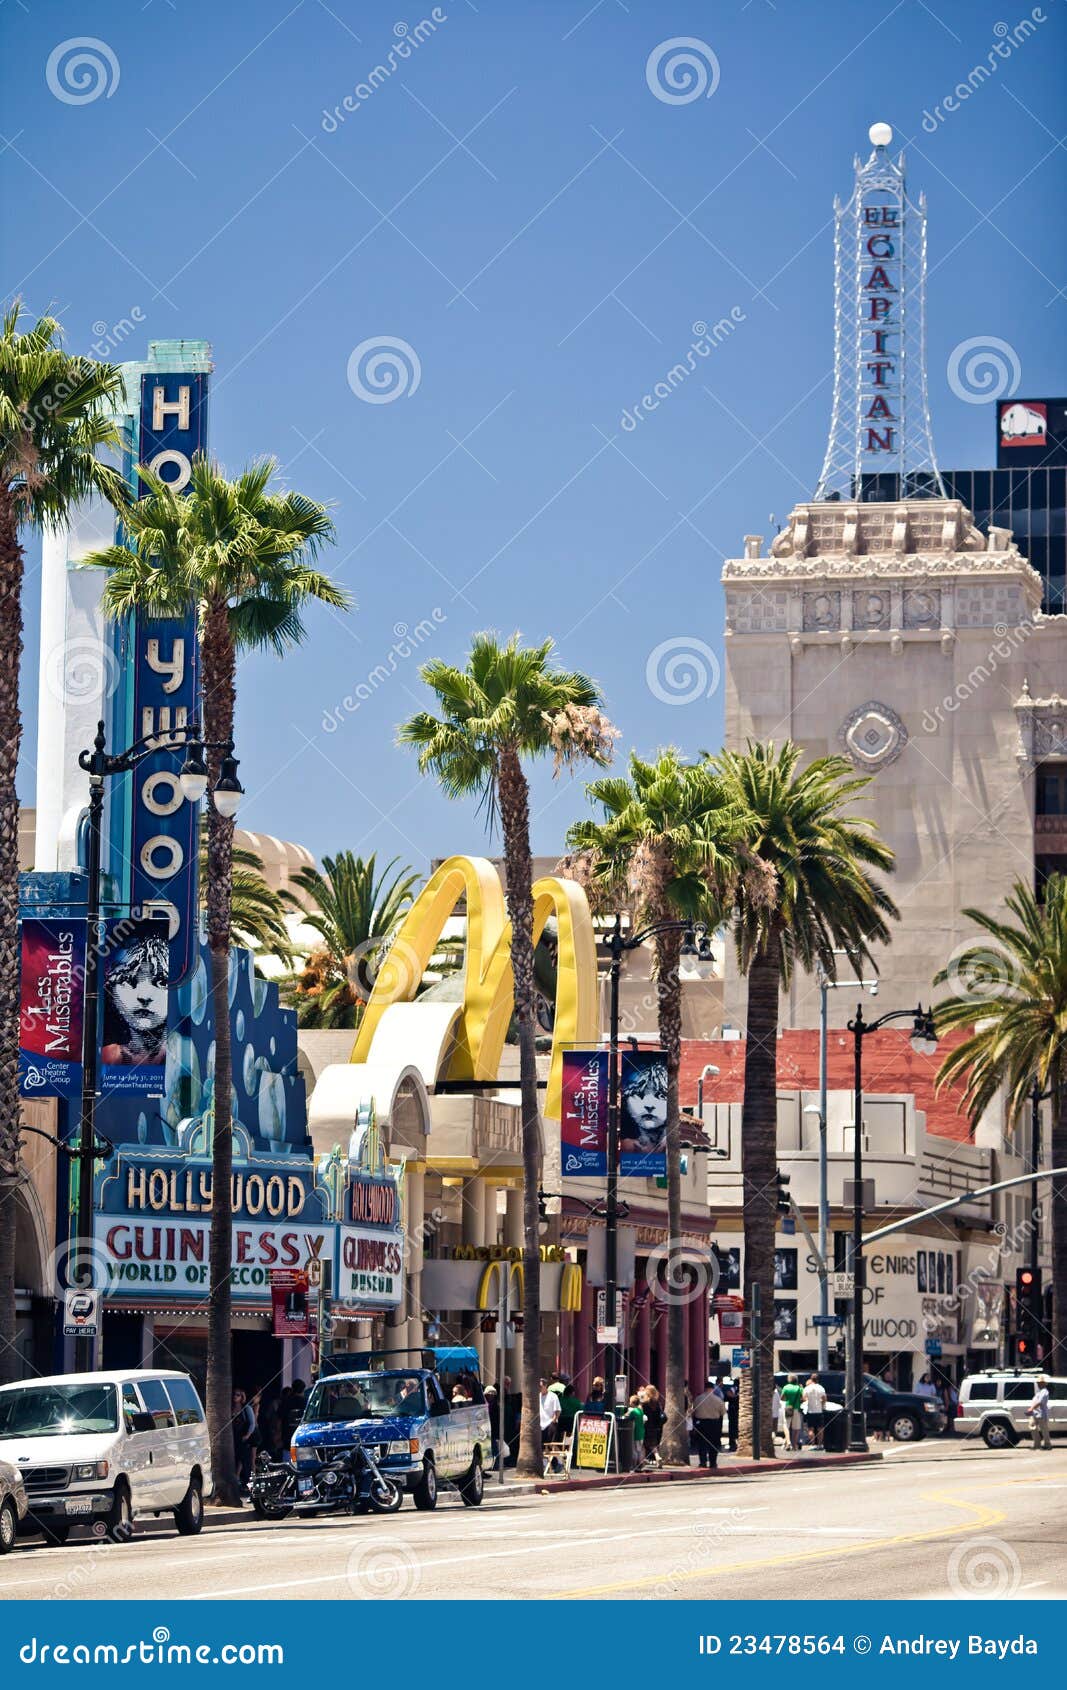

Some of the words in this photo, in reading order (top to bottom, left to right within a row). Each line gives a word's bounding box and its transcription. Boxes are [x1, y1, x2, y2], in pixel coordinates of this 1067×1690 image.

[864, 206, 897, 226] EL
[866, 234, 896, 452] CAPITAN
[140, 386, 193, 941] HOYWOOD
[28, 976, 52, 1015] Les
[41, 1068, 66, 1076] Theatre
[47, 1062, 70, 1070] Center
[50, 1076, 71, 1085] Group
[103, 1074, 117, 1082] June
[566, 1091, 585, 1119] Les
[352, 1182, 394, 1224] HOLLYWOOD
[106, 1225, 301, 1266] GUINESS
[343, 1236, 402, 1275] GUINNESS
[106, 1262, 177, 1283] WORLD
[185, 1266, 209, 1284] OF
[806, 1255, 916, 1275] SENIRS
[351, 1273, 393, 1293] MUSEUM
[804, 1317, 918, 1339] HYWOOD
[592, 1444, 604, 1455] 50
